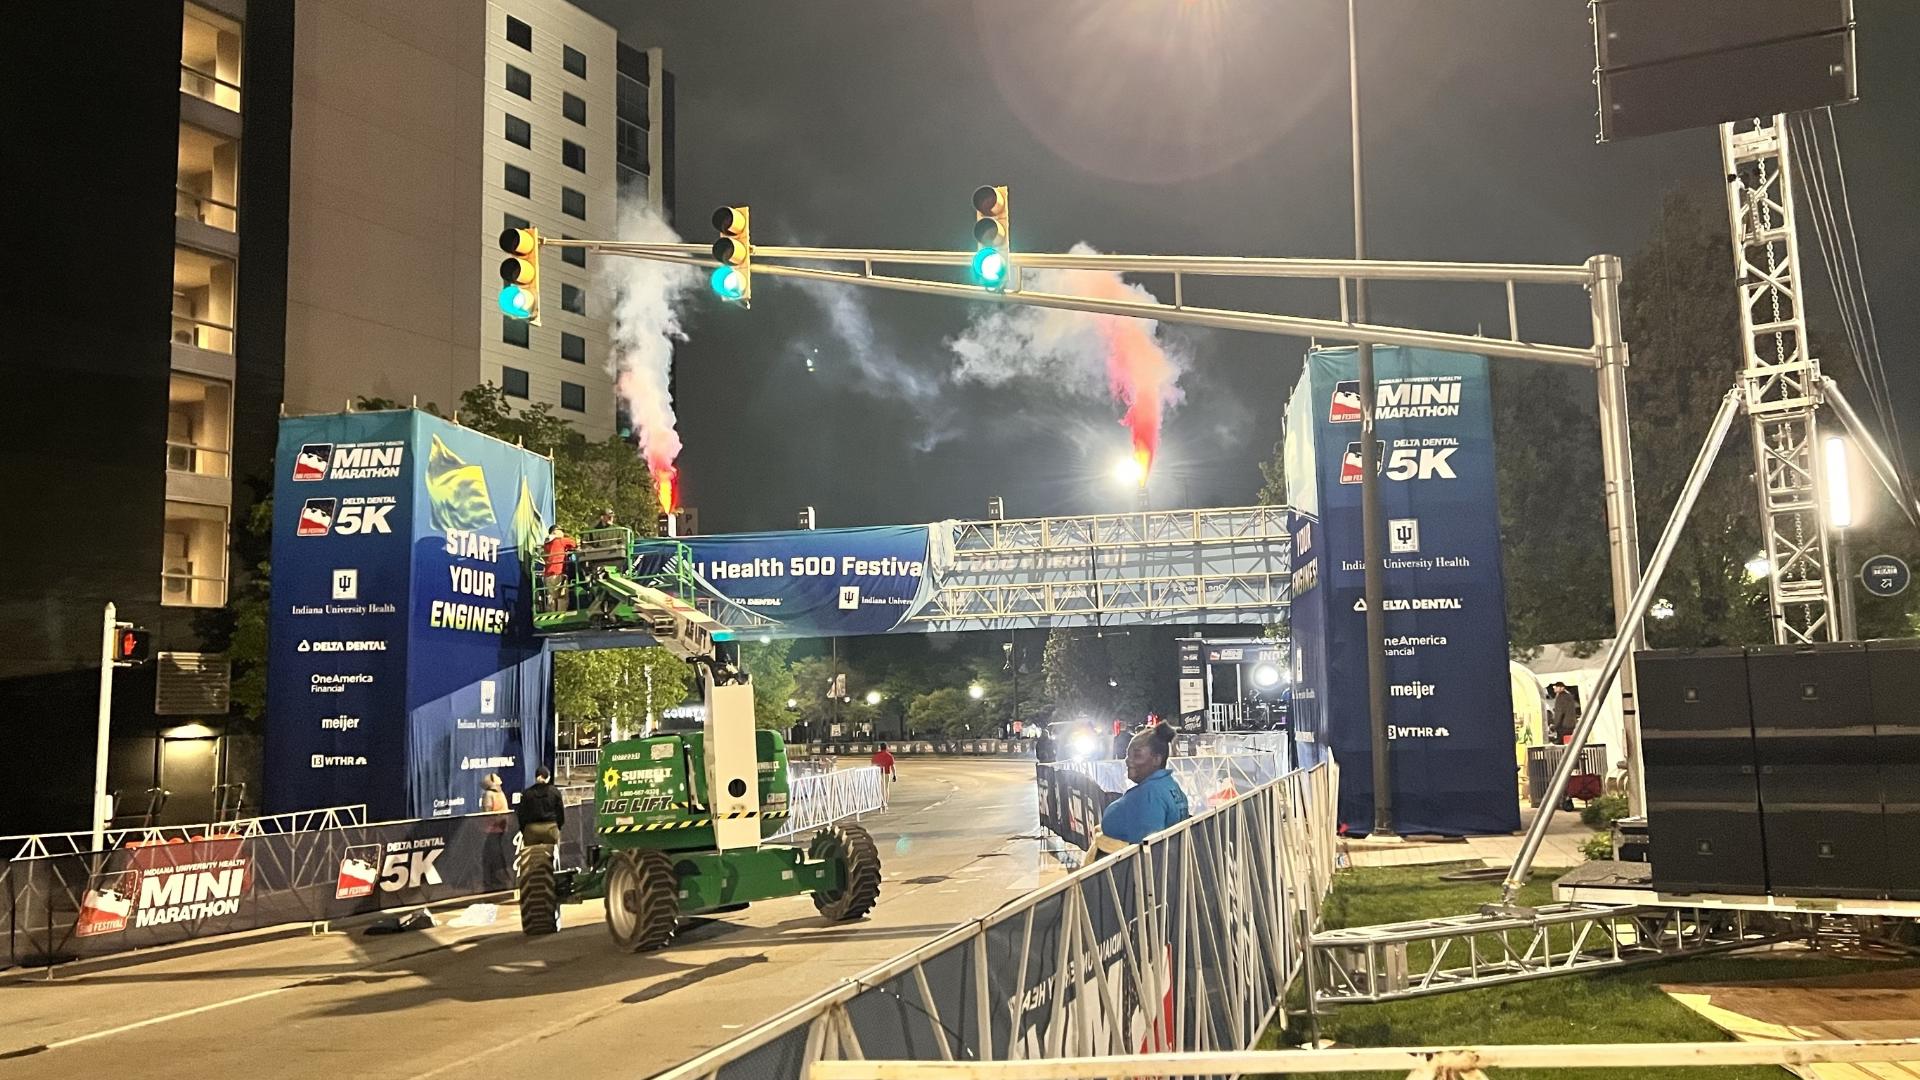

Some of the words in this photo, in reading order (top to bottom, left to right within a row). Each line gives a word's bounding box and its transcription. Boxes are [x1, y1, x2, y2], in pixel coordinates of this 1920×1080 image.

[1376, 382, 1461, 406] MINI
[1375, 404, 1459, 420] MARATHON
[1393, 439, 1420, 447] DELTA
[1423, 438, 1459, 446] DENTAL
[333, 447, 404, 469] MINI
[1386, 448, 1458, 481] 5K
[330, 467, 399, 480] MARATHON
[334, 505, 396, 535] 5K
[446, 528, 500, 563] START
[711, 557, 784, 580] Health
[790, 556, 836, 577] 500
[842, 556, 922, 578] Festiva
[1342, 560, 1366, 571] India
[1383, 558, 1433, 571] University
[1436, 557, 1470, 568] Health
[450, 565, 495, 598] YOUR
[861, 596, 886, 605] Indiana
[888, 596, 914, 606] Univer
[1383, 599, 1411, 611] ELTA
[1412, 598, 1462, 610] DENTAL
[292, 605, 323, 616] Indiana
[325, 604, 367, 617] University
[368, 603, 396, 614] Health
[430, 600, 510, 634] ENGINES!
[313, 641, 344, 652] DELTA
[346, 640, 386, 651] DENTAL
[1383, 635, 1447, 646] neAmerica
[311, 674, 374, 685] OneAmerica
[311, 685, 345, 693] Financial
[1390, 681, 1436, 699] meijer
[321, 715, 360, 732] meijer
[1397, 726, 1434, 738] WTHR
[325, 756, 354, 767] WTHR
[600, 799, 629, 814] JLG
[630, 795, 674, 813] LIFT
[387, 839, 412, 852] DELTA
[413, 836, 445, 848] DENTAL
[144, 866, 174, 876] INDIANA
[176, 861, 218, 873] UNIVERSITY
[218, 859, 246, 868] HEALTH
[379, 848, 444, 893] 5K
[138, 868, 244, 909] MINI
[135, 899, 240, 928] MARATHON
[94, 919, 123, 932] FESTIVAL
